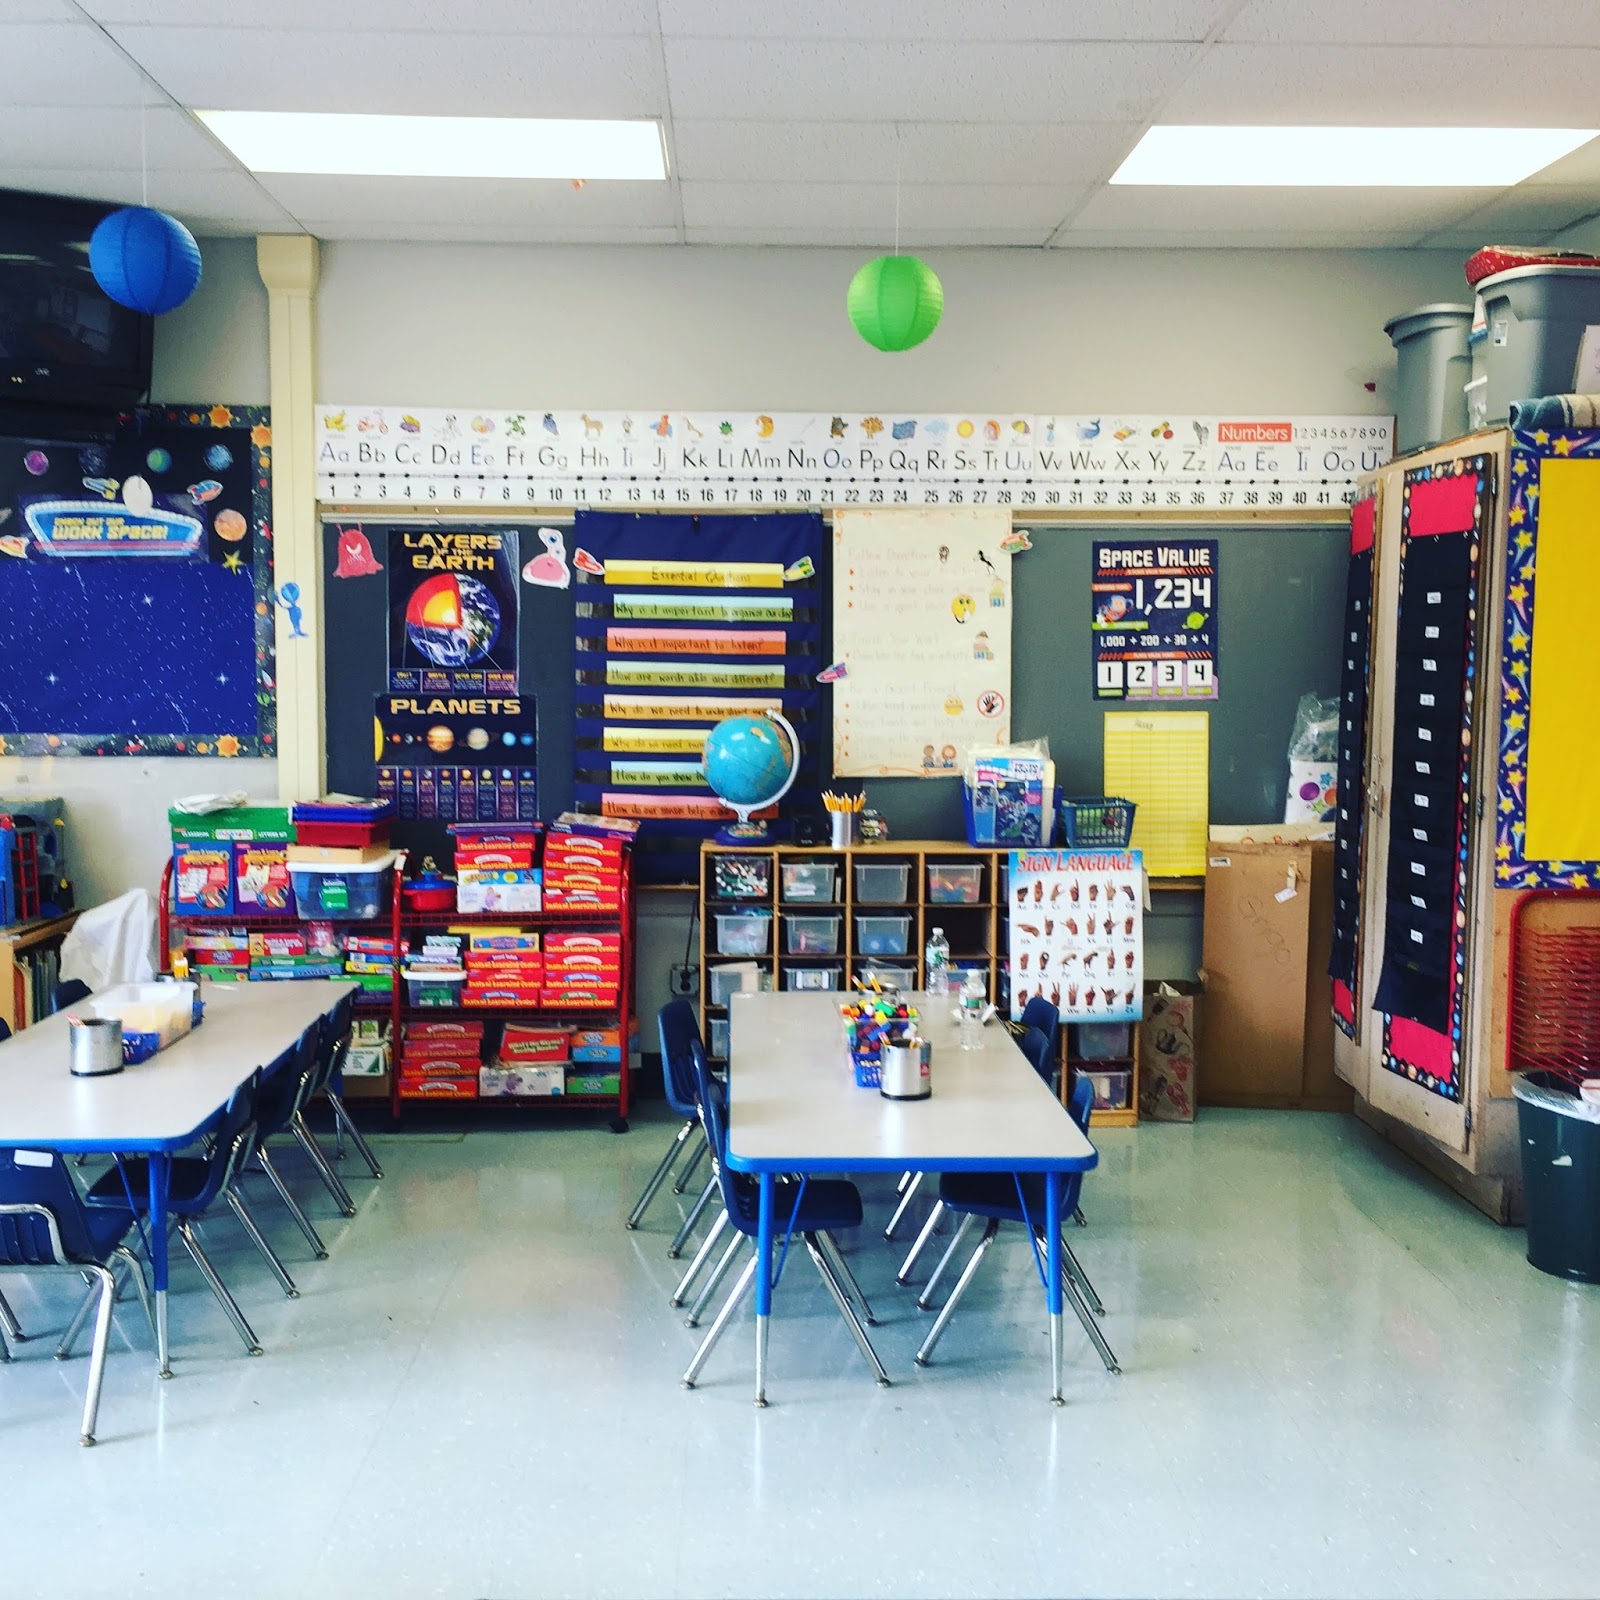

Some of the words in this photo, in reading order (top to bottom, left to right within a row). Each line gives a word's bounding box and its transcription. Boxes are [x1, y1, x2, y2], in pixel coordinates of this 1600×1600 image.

[1221, 426, 1288, 440] Numbers
[320, 442, 350, 463] Aa
[359, 443, 386, 463] Bb
[395, 443, 421, 464] Cc
[432, 444, 461, 465] Dd
[471, 445, 494, 466] Ee
[507, 446, 525, 467] Ff
[538, 446, 568, 470] Gg
[581, 447, 609, 467] Hh
[622, 447, 633, 467] Ii
[653, 447, 667, 473] Jj
[682, 448, 709, 468] Kk
[718, 448, 733, 469] Ll
[741, 448, 781, 469] Mm
[788, 448, 817, 469] Nn
[824, 448, 852, 469] Oo
[860, 449, 884, 474] Pp
[889, 449, 919, 474] Qq
[927, 449, 948, 471] Rr
[954, 450, 977, 471] Ss
[982, 450, 998, 471] Tt
[1005, 450, 1032, 471] Uu
[1039, 451, 1063, 471] Vv
[1070, 451, 1106, 471] Ww
[1115, 451, 1141, 471] Xx
[1149, 451, 1169, 475] Yy
[1182, 451, 1206, 472] Zz
[1218, 452, 1246, 472] Aa
[1256, 452, 1279, 472] Ee
[1297, 451, 1309, 472] Ii
[1323, 451, 1355, 473] Oo
[329, 485, 335, 497] 1
[354, 485, 362, 498] 2
[378, 485, 387, 498] 3
[403, 486, 412, 499] 4
[428, 486, 437, 499] 5
[453, 486, 462, 499] 6
[478, 487, 487, 499] 7
[503, 487, 511, 500] 8
[527, 487, 535, 500] 9
[549, 488, 562, 501] 10
[573, 488, 586, 501] 11
[599, 489, 612, 501] 12
[628, 489, 641, 501] 13
[652, 489, 665, 501] 14
[676, 489, 690, 502] 15
[700, 489, 714, 502] 16
[724, 489, 739, 502] 17
[749, 489, 763, 503] 18
[773, 489, 787, 503] 19
[797, 489, 811, 503] 20
[821, 490, 835, 503] 21
[845, 490, 860, 503] 22
[869, 490, 884, 503] 23
[893, 490, 908, 503] 24
[924, 490, 939, 503] 25
[949, 490, 963, 503] 26
[973, 491, 987, 504] 27
[997, 491, 1012, 504] 28
[1021, 491, 1036, 504] 29
[1045, 491, 1060, 504] 30
[1069, 491, 1083, 504] 31
[1093, 491, 1108, 504] 32
[1117, 492, 1132, 504] 33
[1142, 492, 1157, 504] 34
[1166, 492, 1181, 504] 35
[1190, 492, 1205, 505] 36
[1219, 492, 1234, 505] 37
[1243, 492, 1258, 505] 38
[1268, 492, 1283, 505] 39
[1292, 492, 1307, 505] 40
[1316, 492, 1331, 505] 41
[52, 525, 103, 540] WORK
[107, 525, 169, 540] SPACE!
[403, 533, 502, 550] LAYERS
[433, 548, 448, 556] OF
[452, 549, 474, 557] THE
[1099, 548, 1154, 568] SPACE
[1157, 547, 1210, 567] VALUE
[412, 555, 495, 570] EARTH
[651, 567, 698, 582] Essential
[1136, 578, 1212, 616] 1,234
[616, 603, 634, 618] Why
[662, 605, 715, 617] important
[614, 635, 634, 650] Why
[662, 639, 710, 651] important
[1100, 635, 1126, 648] 1,000
[1129, 636, 1138, 646] +
[1140, 634, 1160, 647] 200
[1163, 635, 1172, 645] +
[1174, 634, 1188, 647] 30
[1191, 635, 1200, 645] +
[1202, 634, 1210, 645] 4
[610, 668, 631, 681] How
[1108, 666, 1112, 683] 1
[1135, 666, 1146, 683] 2
[1165, 665, 1175, 682] 3
[1194, 664, 1205, 682] 4
[390, 698, 521, 715] PLANETS
[610, 701, 627, 715] Why
[669, 704, 691, 716] need
[615, 768, 637, 782] How
[641, 771, 652, 781] do
[656, 773, 671, 785] you
[607, 801, 628, 815] How
[631, 804, 642, 815] do
[688, 803, 706, 818] help
[1018, 852, 1053, 872] SIGN
[1057, 851, 1135, 872] LANGUAGE
